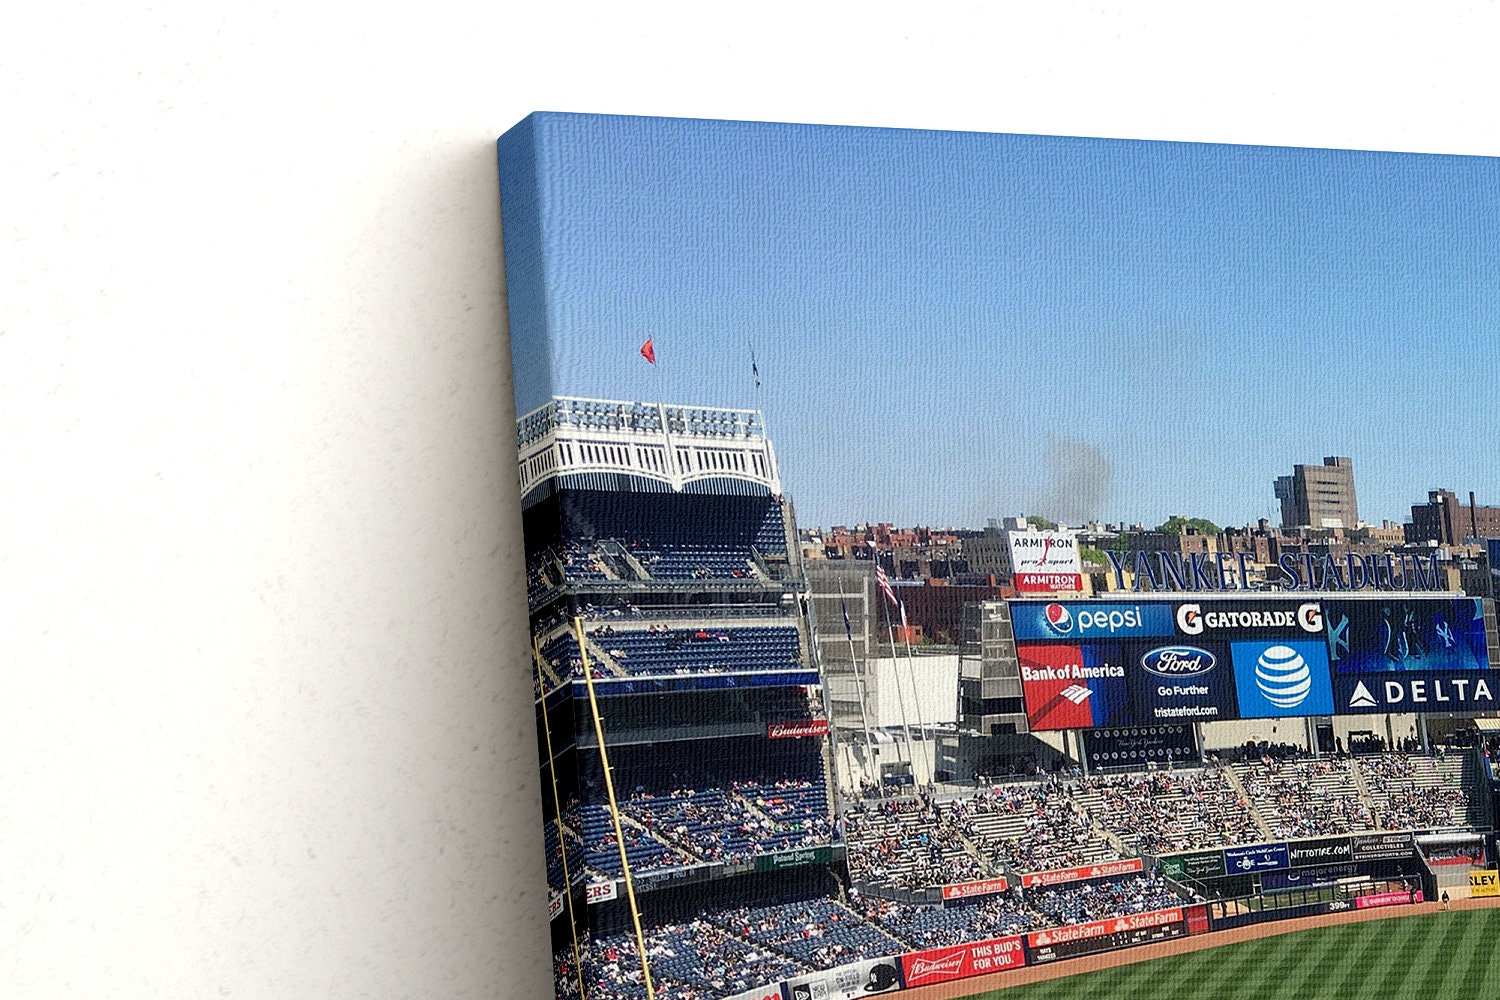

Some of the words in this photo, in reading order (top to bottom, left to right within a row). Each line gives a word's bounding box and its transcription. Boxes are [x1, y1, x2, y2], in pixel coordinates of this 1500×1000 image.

[1014, 538, 1073, 548] ARMITRON
[1105, 549, 1260, 591] YANKEE
[1277, 551, 1444, 592] STADIUM
[1023, 575, 1076, 585] ARMITRON
[1078, 606, 1143, 633] pepsi
[1204, 611, 1296, 628] GATORADE
[1156, 650, 1203, 672] Ford
[1021, 665, 1055, 681] Bank
[1054, 665, 1070, 680] of
[1072, 663, 1125, 679] America
[1157, 686, 1173, 697] Go
[1173, 685, 1209, 696] Further
[1384, 679, 1493, 704] DELTA
[1154, 705, 1218, 718] tristateford.com
[771, 724, 828, 737] Budweiser
[1290, 844, 1351, 860] NITTOTIRE.COM
[1361, 843, 1404, 851] COLLECTIBLES
[971, 945, 993, 959] THIS
[994, 939, 1022, 955] BUD'S
[914, 958, 962, 975] Budweiser
[973, 958, 993, 971] FOR
[993, 953, 1014, 967] YOU.
